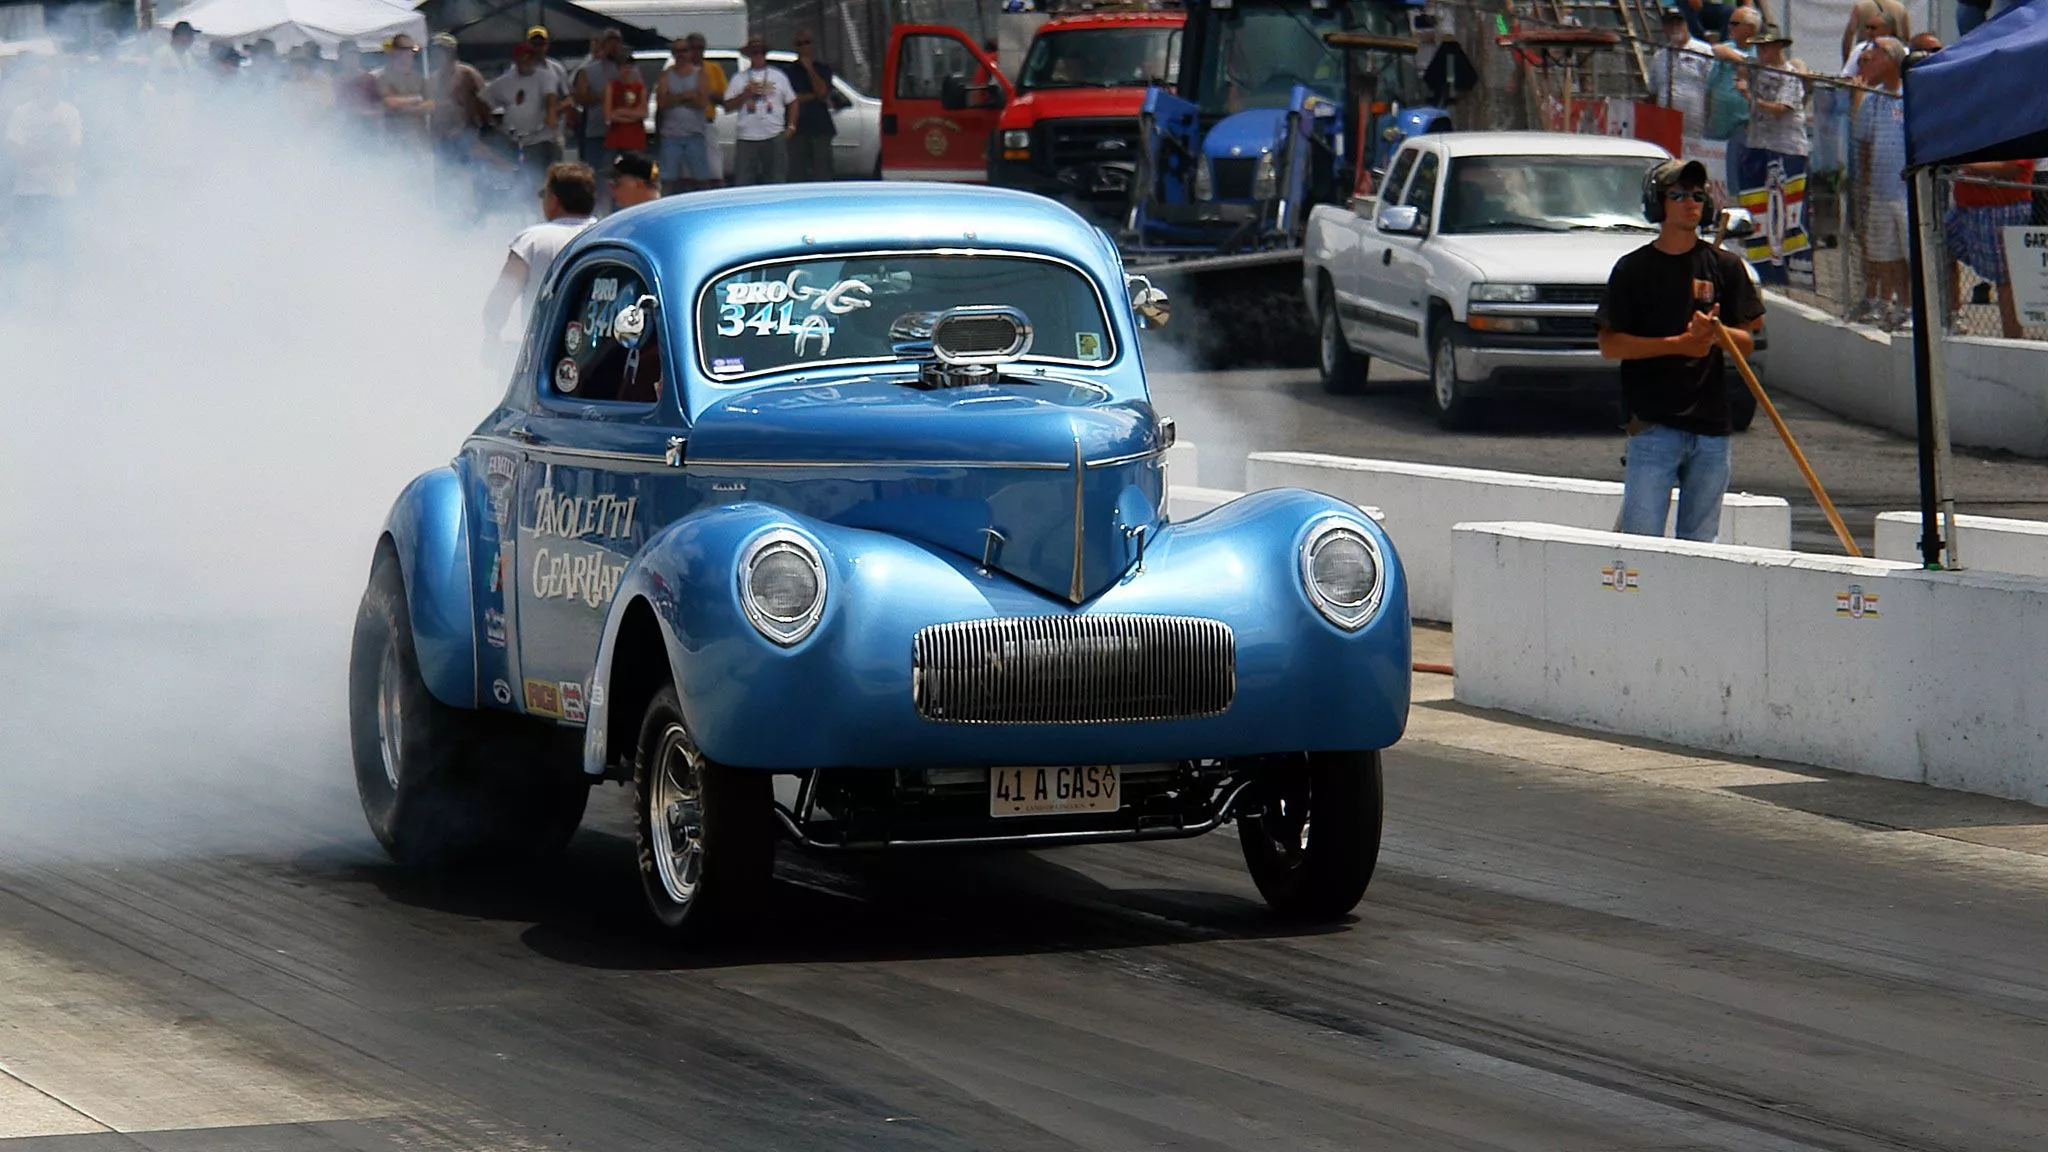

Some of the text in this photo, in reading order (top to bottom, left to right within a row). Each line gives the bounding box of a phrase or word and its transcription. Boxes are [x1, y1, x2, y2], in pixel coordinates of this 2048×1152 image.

[592, 278, 618, 301] PRO
[726, 280, 788, 304] PRO
[717, 300, 795, 337] 341
[532, 547, 630, 608] GEARHAR
[996, 770, 1025, 801] 41
[1034, 769, 1048, 800] A
[1056, 767, 1100, 799] GAS
